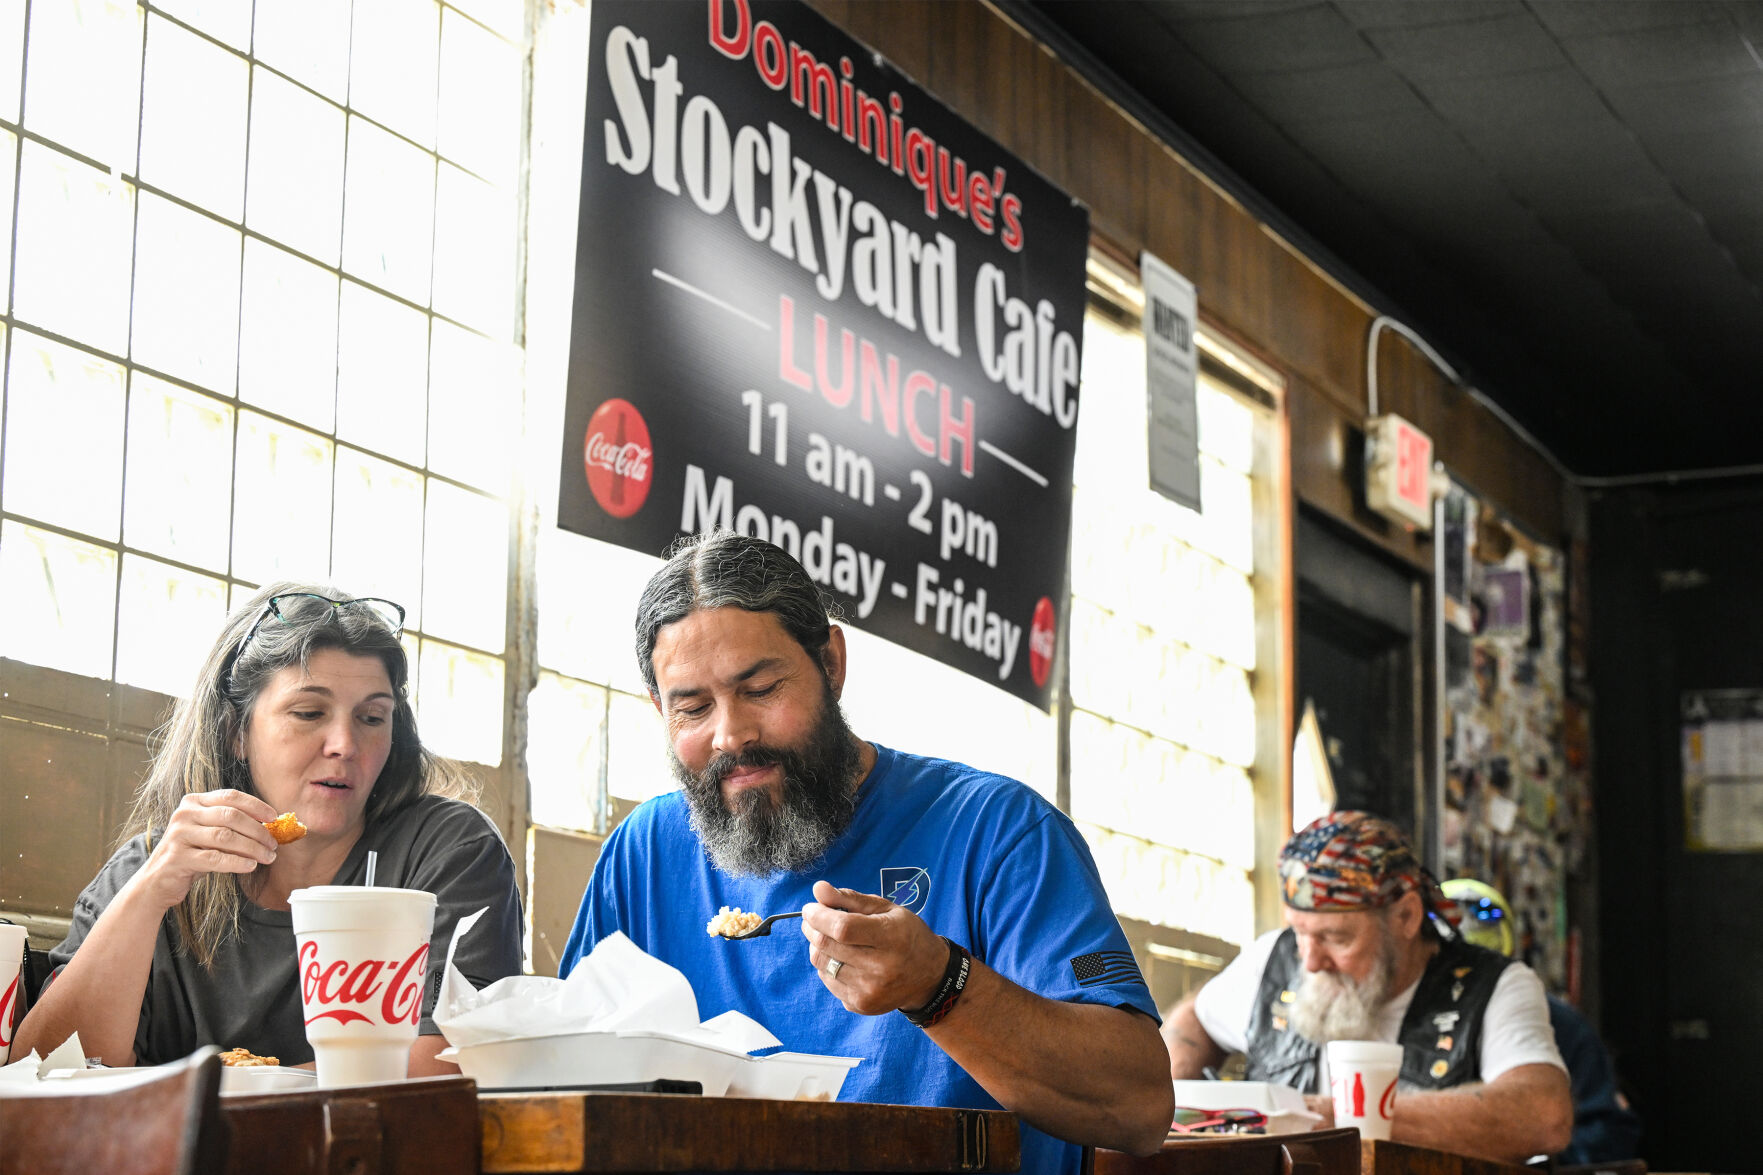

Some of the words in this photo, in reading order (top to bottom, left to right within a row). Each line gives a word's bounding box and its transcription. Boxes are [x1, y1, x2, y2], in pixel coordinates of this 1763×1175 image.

[708, 0, 1024, 253] Dominique's
[604, 25, 961, 358] Stockyard
[974, 262, 1079, 429] Cafe
[780, 294, 975, 477] LUNCH
[741, 390, 788, 466] 11
[806, 433, 875, 507] am
[908, 470, 933, 534] 2
[941, 498, 998, 568] pm
[915, 563, 1022, 681] Friday
